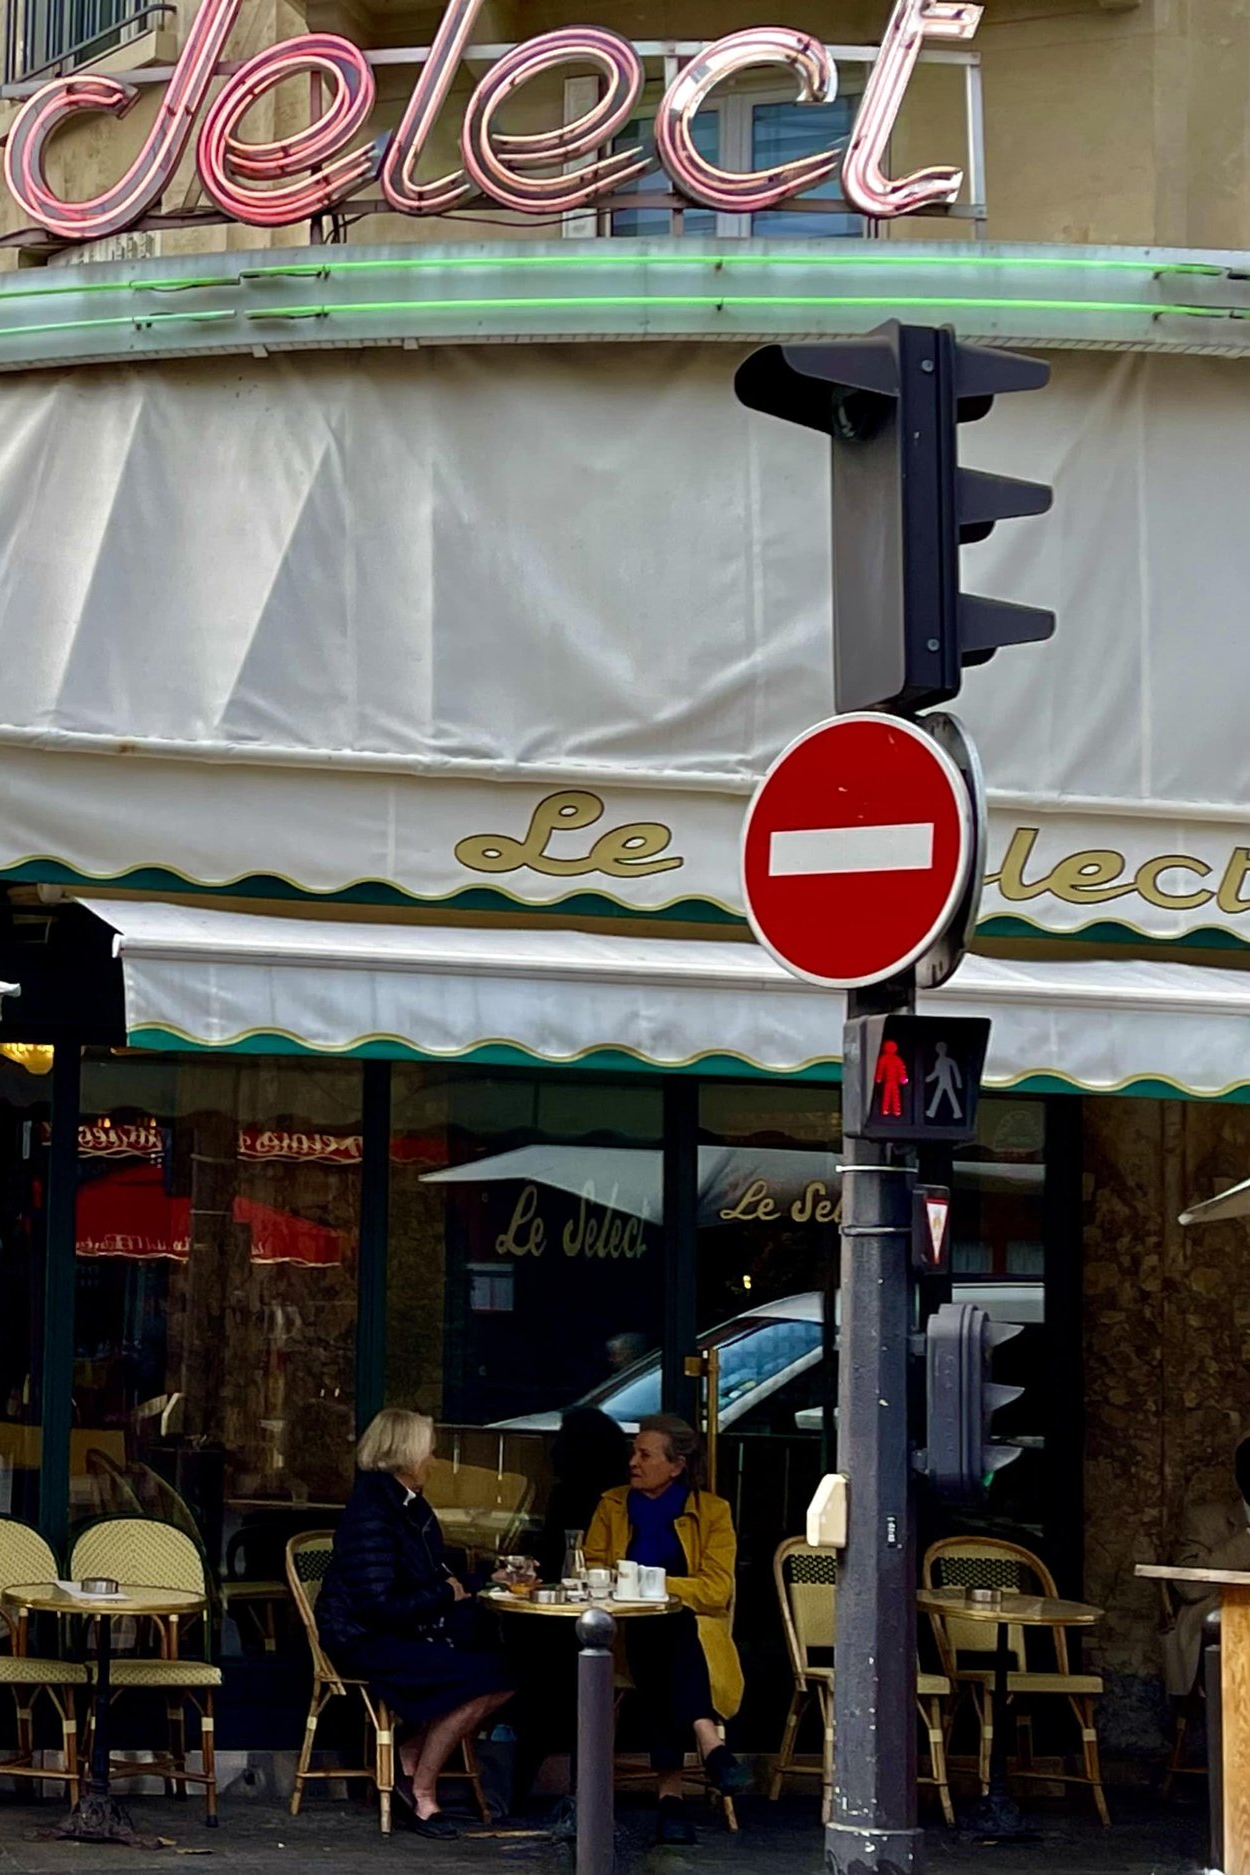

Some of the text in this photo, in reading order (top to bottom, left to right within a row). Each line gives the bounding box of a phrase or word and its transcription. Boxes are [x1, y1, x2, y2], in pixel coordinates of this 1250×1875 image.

[453, 789, 1250, 914] Le lect
[495, 1178, 649, 1258] Le Select
[719, 1179, 781, 1221] Le
